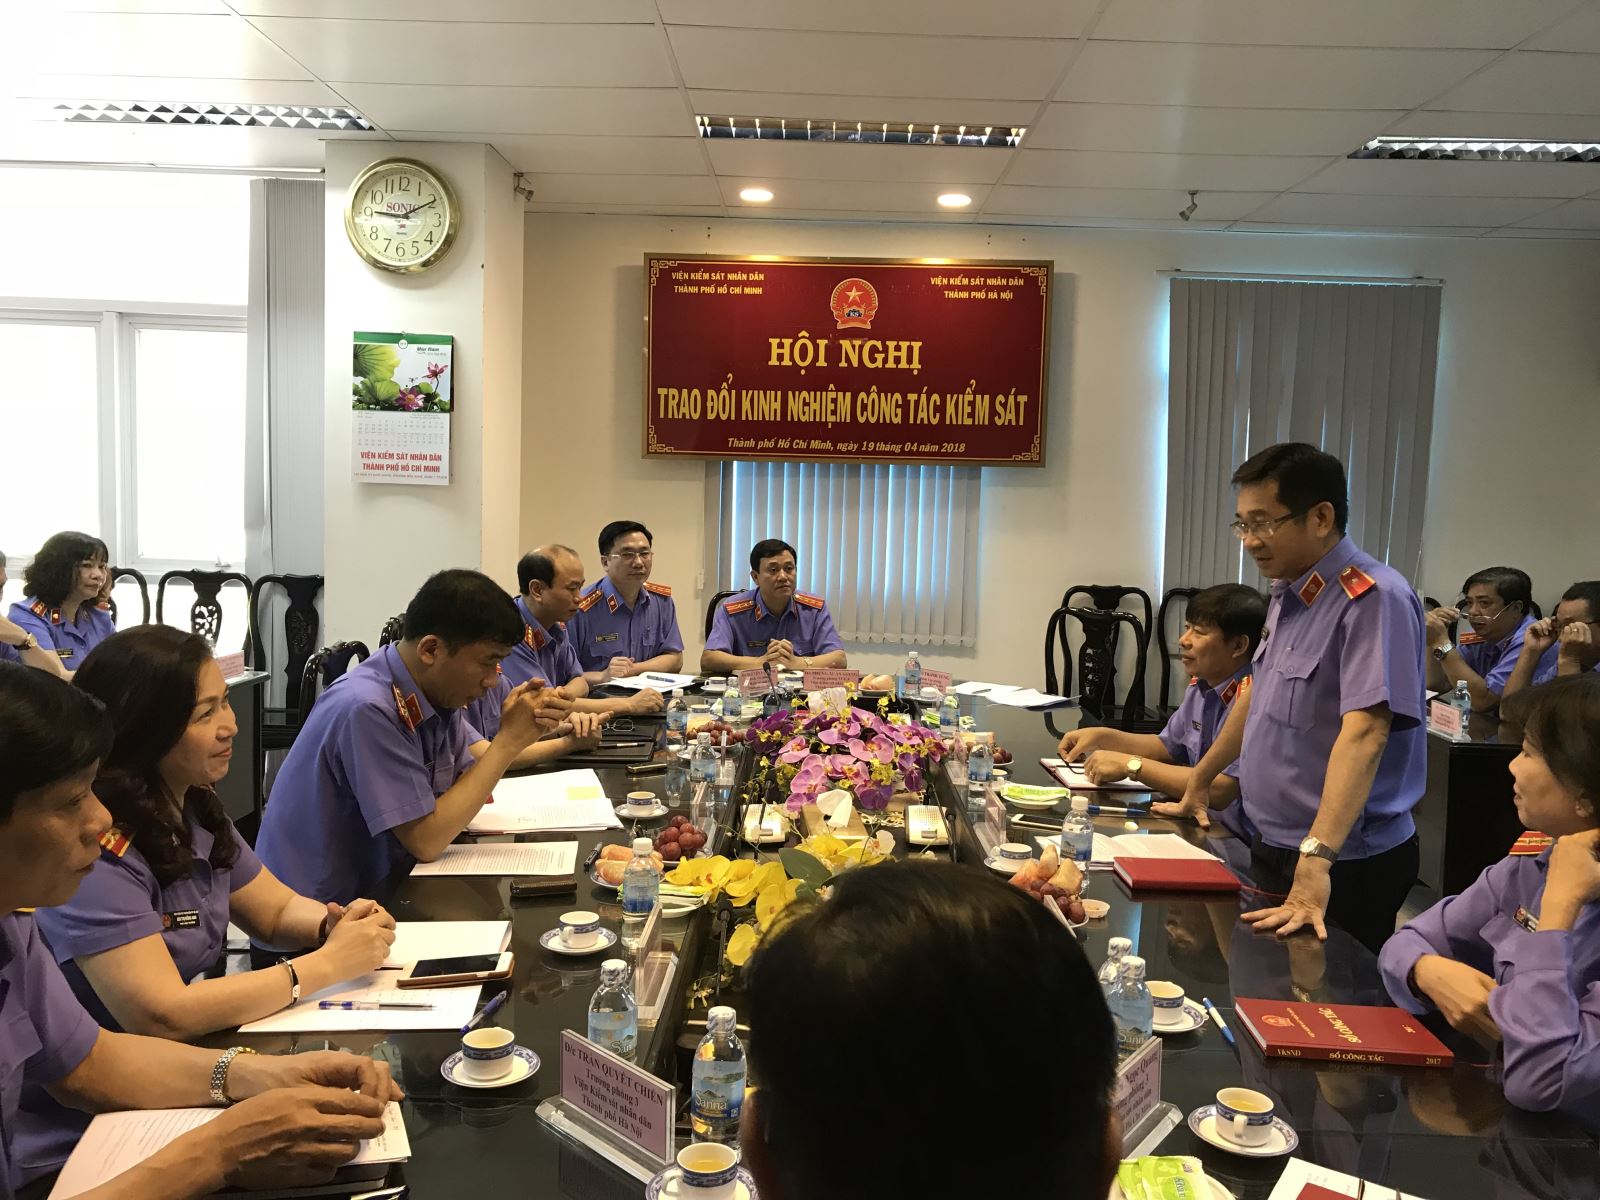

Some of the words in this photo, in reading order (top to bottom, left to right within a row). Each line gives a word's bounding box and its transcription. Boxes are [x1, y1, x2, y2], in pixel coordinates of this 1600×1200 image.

[385, 179, 394, 194] 11
[399, 176, 411, 192] 12
[371, 189, 384, 205] 10
[363, 206, 374, 218] 9
[433, 212, 442, 228] 3
[369, 225, 379, 241] 8
[424, 230, 434, 246] 4
[383, 237, 392, 253] 7
[395, 242, 406, 257] 6
[411, 240, 420, 256] 5
[671, 270, 689, 282] VIỆN
[690, 268, 710, 281] KIỂM
[711, 271, 725, 281] SÁT
[727, 271, 748, 281] NHÂN
[749, 271, 765, 282] DÂN
[930, 276, 948, 287] VIỆN
[949, 273, 969, 286] KIỂM
[970, 275, 986, 286] SÁT
[986, 276, 1007, 287] NHÂN
[1008, 276, 1024, 287] DÂN
[674, 283, 699, 295] THÀNH
[700, 283, 716, 295] PHỐ
[717, 283, 728, 295] HỒ
[729, 284, 743, 295] CHÍ
[744, 286, 763, 295] MINH
[943, 288, 969, 300] THÀNH
[970, 287, 986, 300] PHỐ
[987, 288, 998, 300] HÀ
[1000, 289, 1013, 301] NỘI
[768, 330, 829, 376] HỘI
[838, 339, 923, 376] NGHỊ
[657, 387, 702, 421] TRAO
[706, 372, 736, 421] ĐỔI
[741, 389, 782, 422] KINH
[787, 383, 852, 429] NGHIỆM
[856, 385, 903, 425] CÔNG
[907, 386, 941, 426] TÁC
[945, 379, 990, 426] KIỂM
[994, 387, 1028, 426] SÁT
[727, 437, 756, 449] Thành
[757, 437, 777, 450] phố
[777, 437, 792, 449] Hồ
[792, 438, 808, 450] Chí
[809, 438, 834, 452] Minh,
[836, 440, 859, 453] ngày
[861, 441, 875, 452] 19
[875, 441, 902, 453] tháng
[904, 442, 918, 453] 04
[918, 443, 939, 453] năm
[940, 442, 966, 453] 2018
[1117, 1030, 1145, 1045] Sann
[1342, 1052, 1366, 1061] CÔNG
[1425, 1057, 1441, 1065] 2017
[695, 1090, 728, 1110] Sanna
